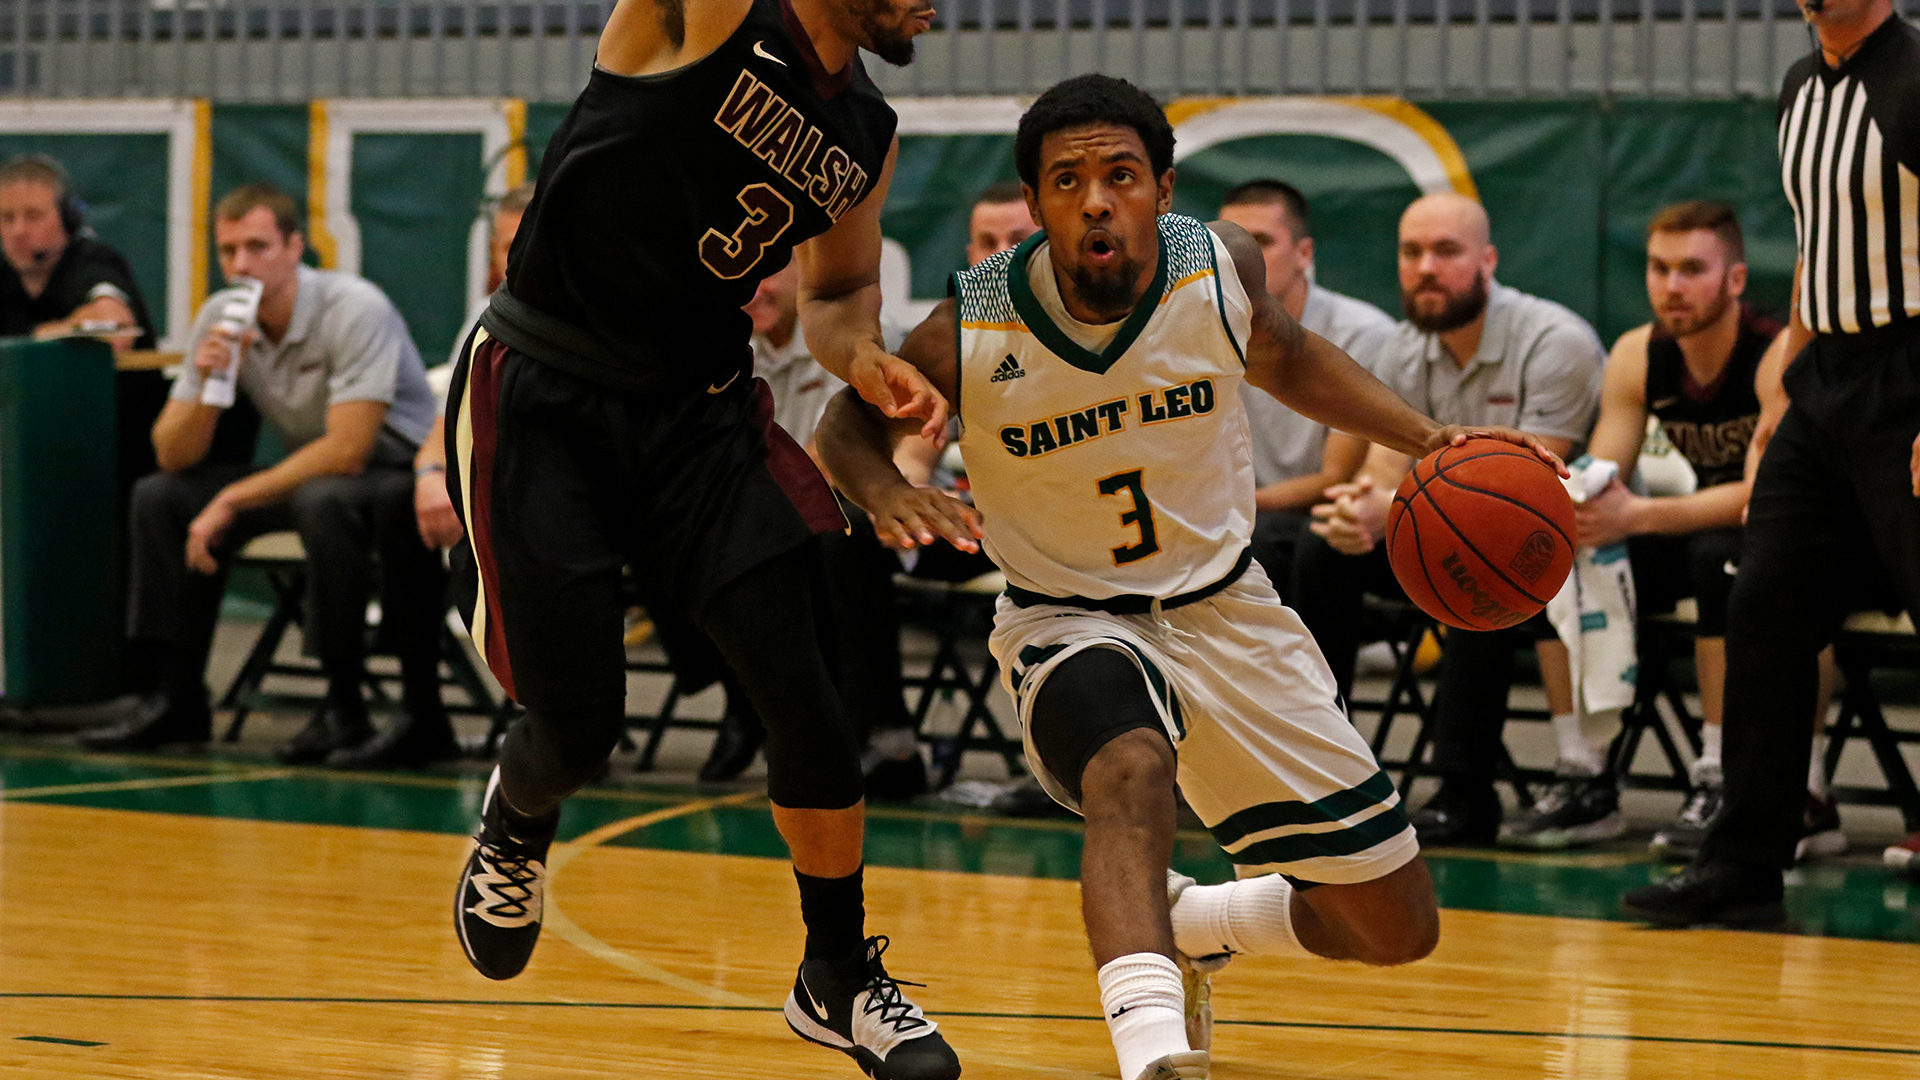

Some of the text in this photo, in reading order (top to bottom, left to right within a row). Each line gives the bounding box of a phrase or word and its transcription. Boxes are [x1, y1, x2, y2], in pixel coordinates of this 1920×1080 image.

[713, 68, 869, 225] WALSH
[698, 182, 794, 280] 3
[990, 369, 1026, 383] adidas
[998, 376, 1216, 459] SAINT LEO
[1095, 467, 1162, 567] 3
[1441, 552, 1531, 626] Wilson
